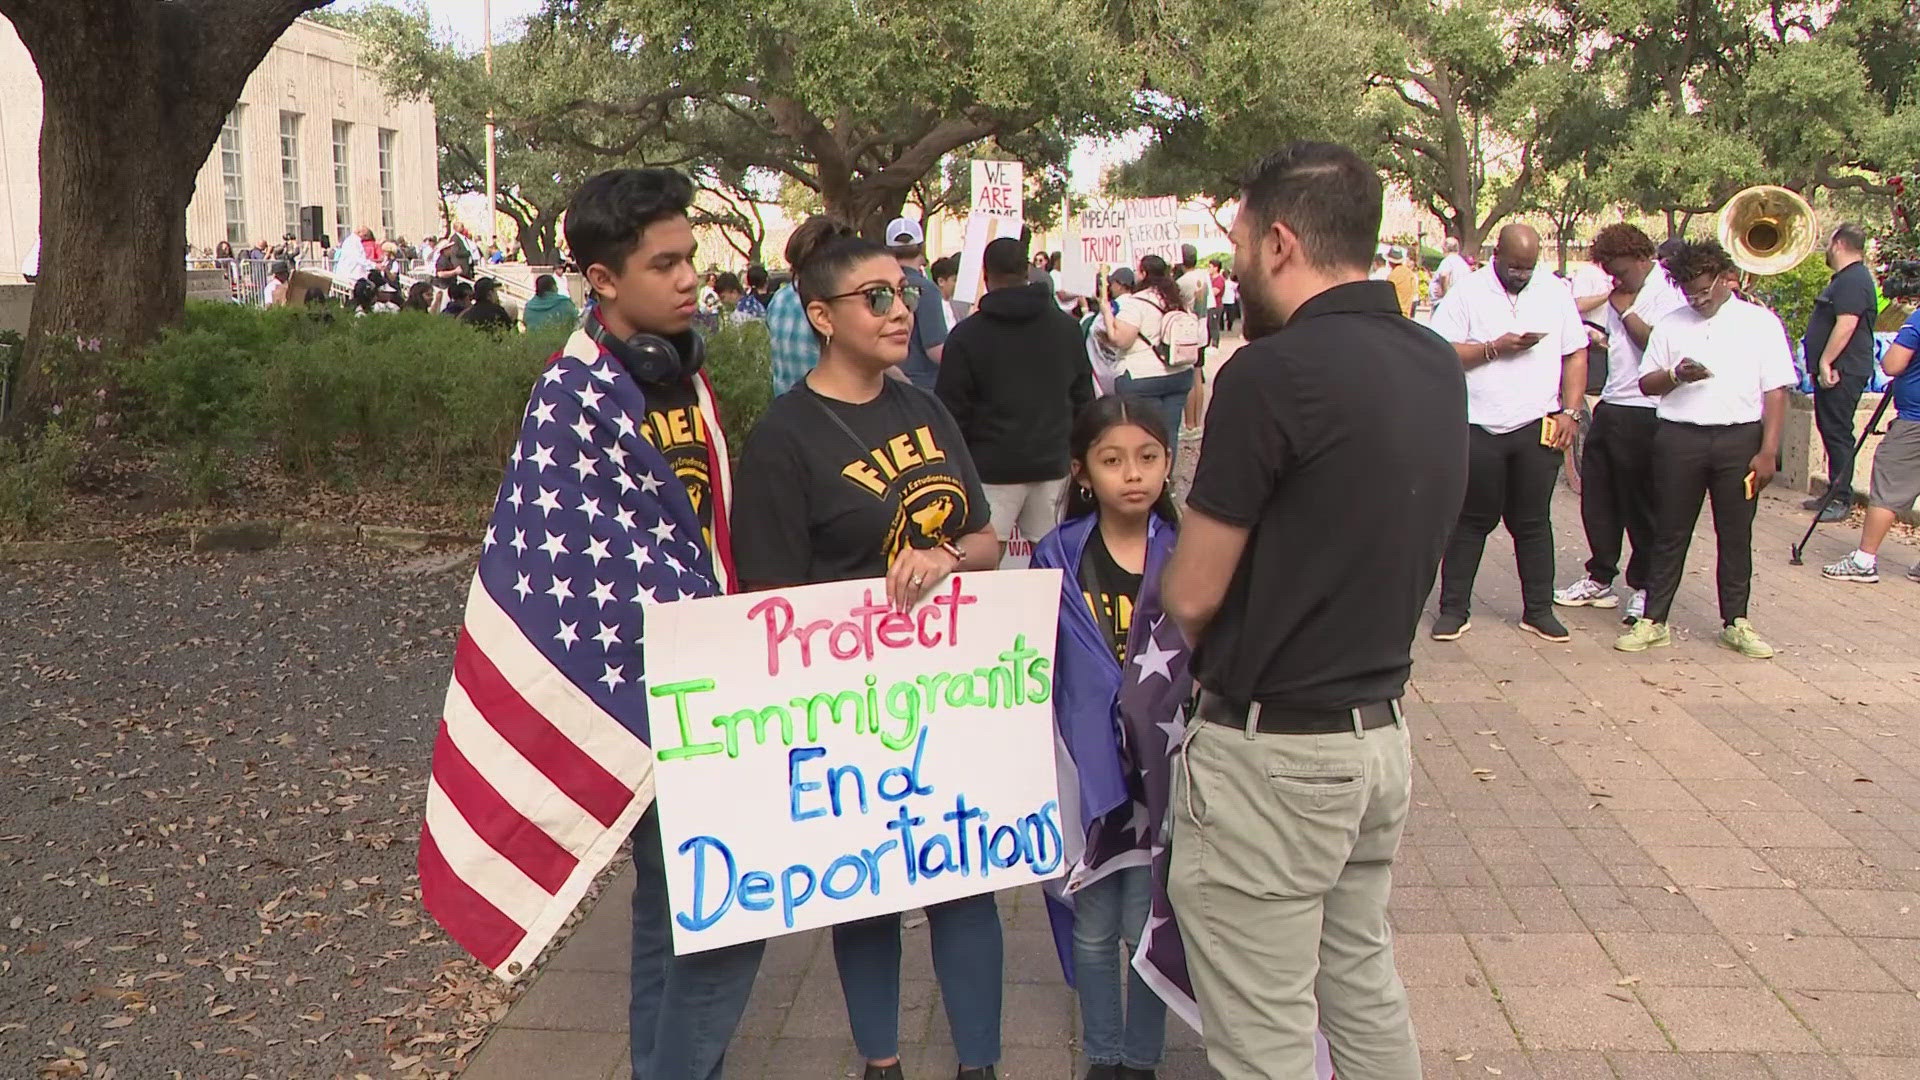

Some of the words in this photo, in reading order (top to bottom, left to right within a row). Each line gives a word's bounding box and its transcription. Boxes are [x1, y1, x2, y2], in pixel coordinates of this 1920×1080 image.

[978, 186, 1012, 208] ARE
[984, 162, 1011, 186] WE
[1081, 210, 1126, 229] IMPEACH
[1125, 197, 1172, 220] PROTECT
[1081, 235, 1122, 263] TRUMP
[841, 425, 946, 502] FIEL
[747, 575, 978, 677] Protect
[649, 633, 1052, 762] Immigrants
[788, 724, 934, 823] End
[675, 792, 1063, 932] Deportations
